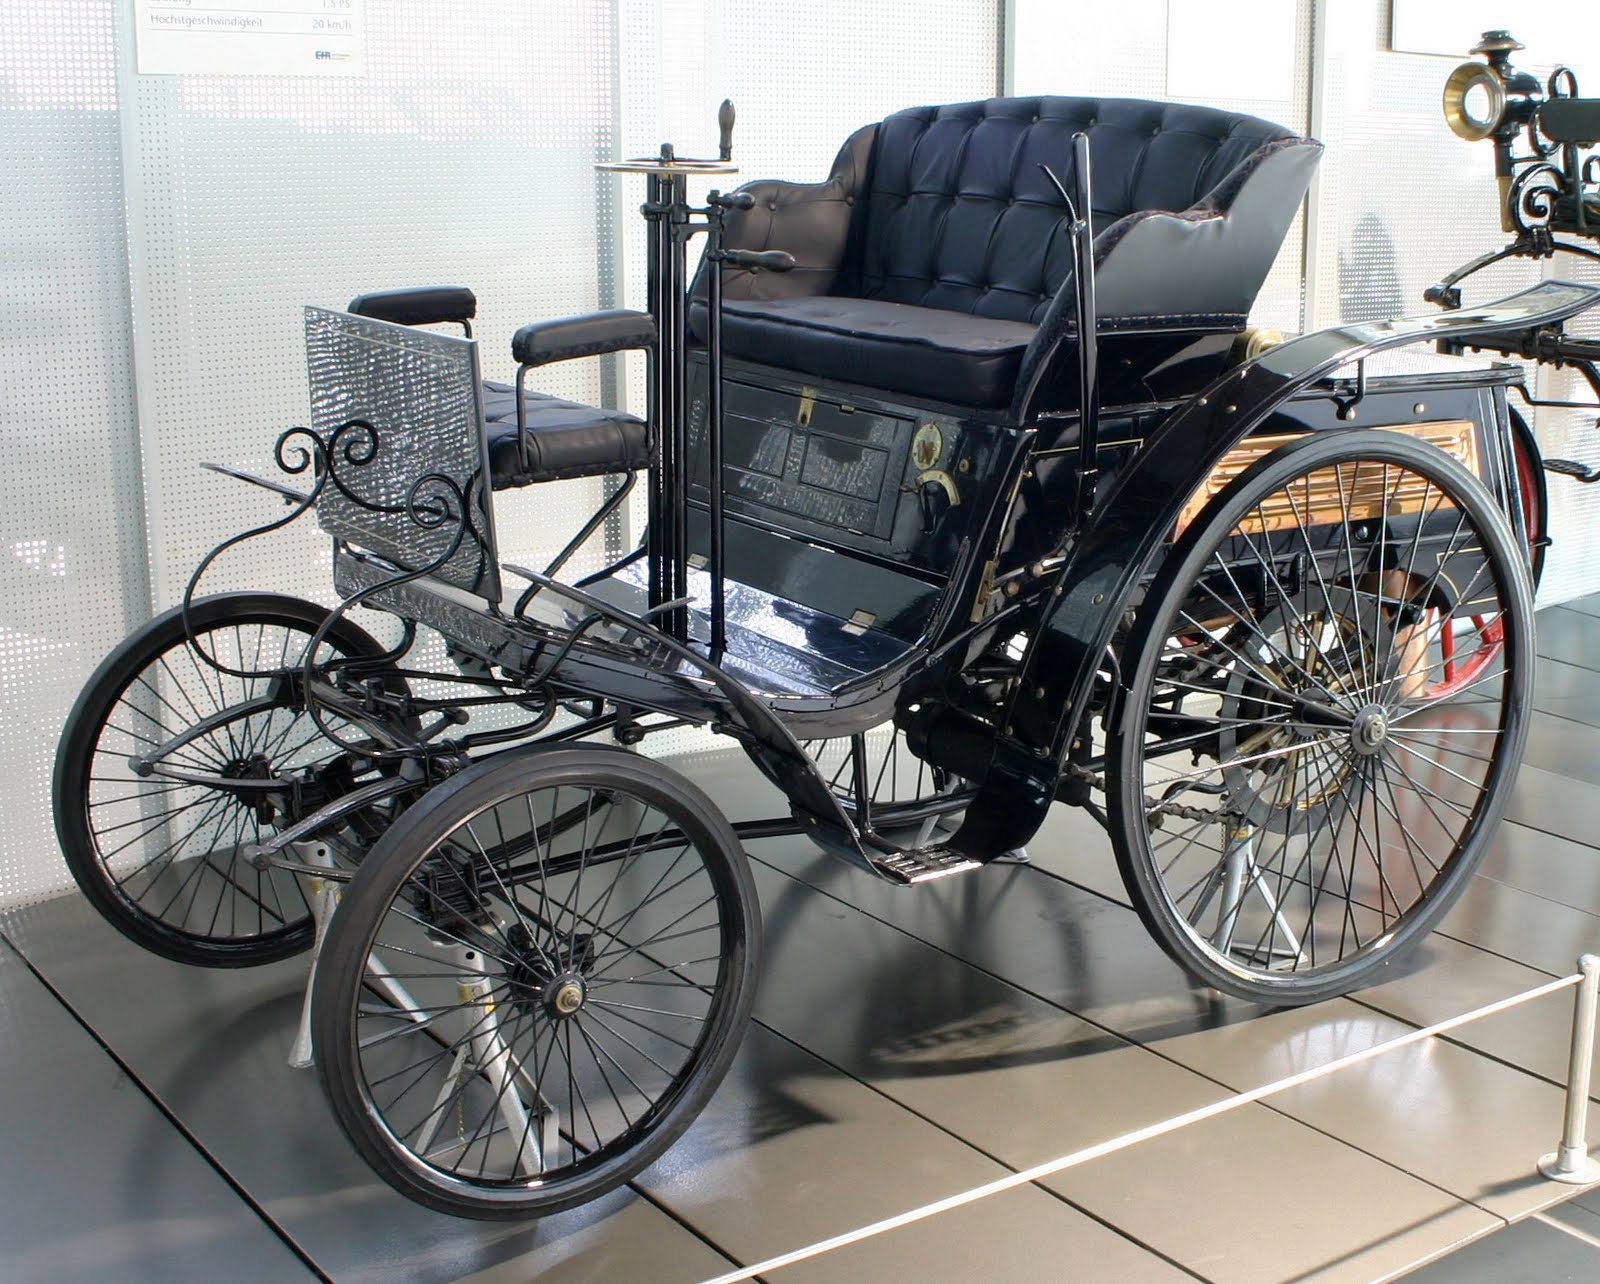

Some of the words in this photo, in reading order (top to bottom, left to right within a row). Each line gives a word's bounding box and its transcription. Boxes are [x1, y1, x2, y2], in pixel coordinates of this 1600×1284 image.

[339, 0, 350, 9] PS
[150, 13, 263, 29] Höchstgeschwindigkeit
[312, 18, 325, 29] 20
[327, 18, 352, 30] km/h
